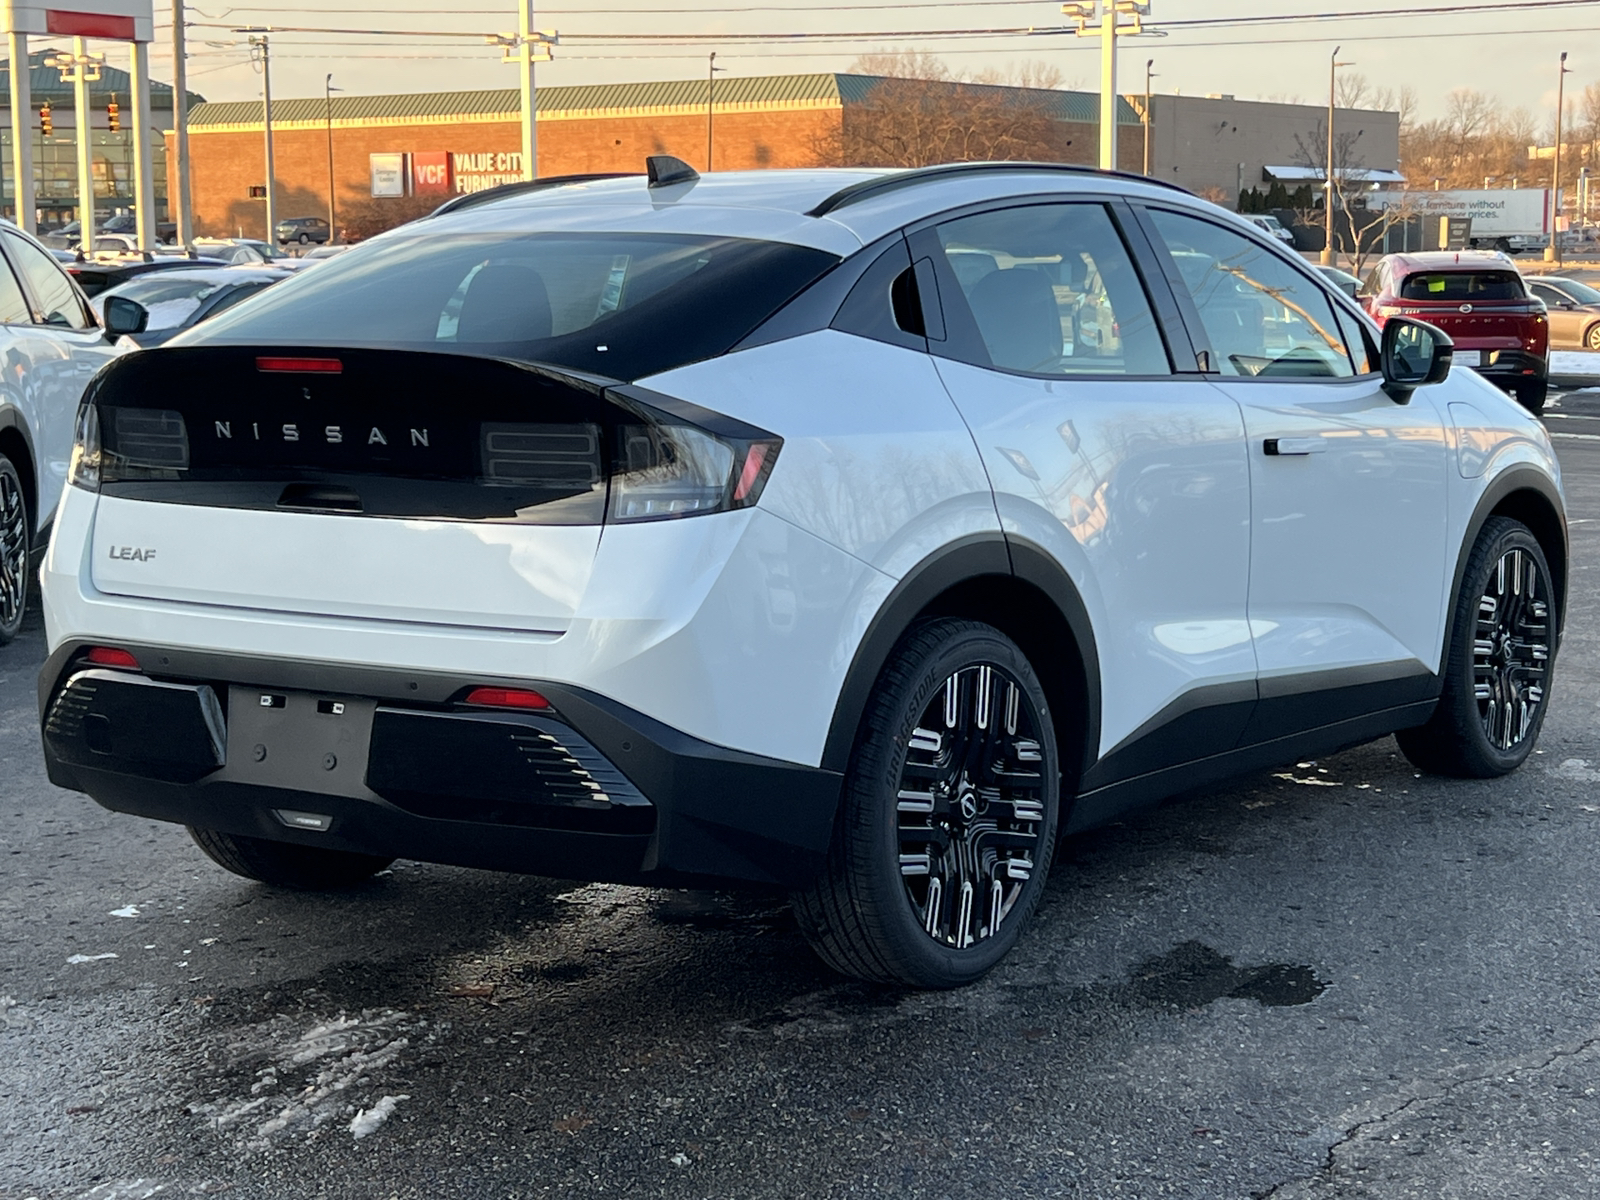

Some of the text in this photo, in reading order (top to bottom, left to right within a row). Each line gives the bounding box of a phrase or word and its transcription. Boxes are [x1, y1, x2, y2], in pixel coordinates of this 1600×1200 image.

[454, 152, 495, 172] VALUE
[416, 165, 446, 185] VCF
[1469, 200, 1505, 209] without
[1468, 210, 1499, 219] prices.
[214, 420, 430, 447] NISSAN
[109, 545, 156, 562] LEAF
